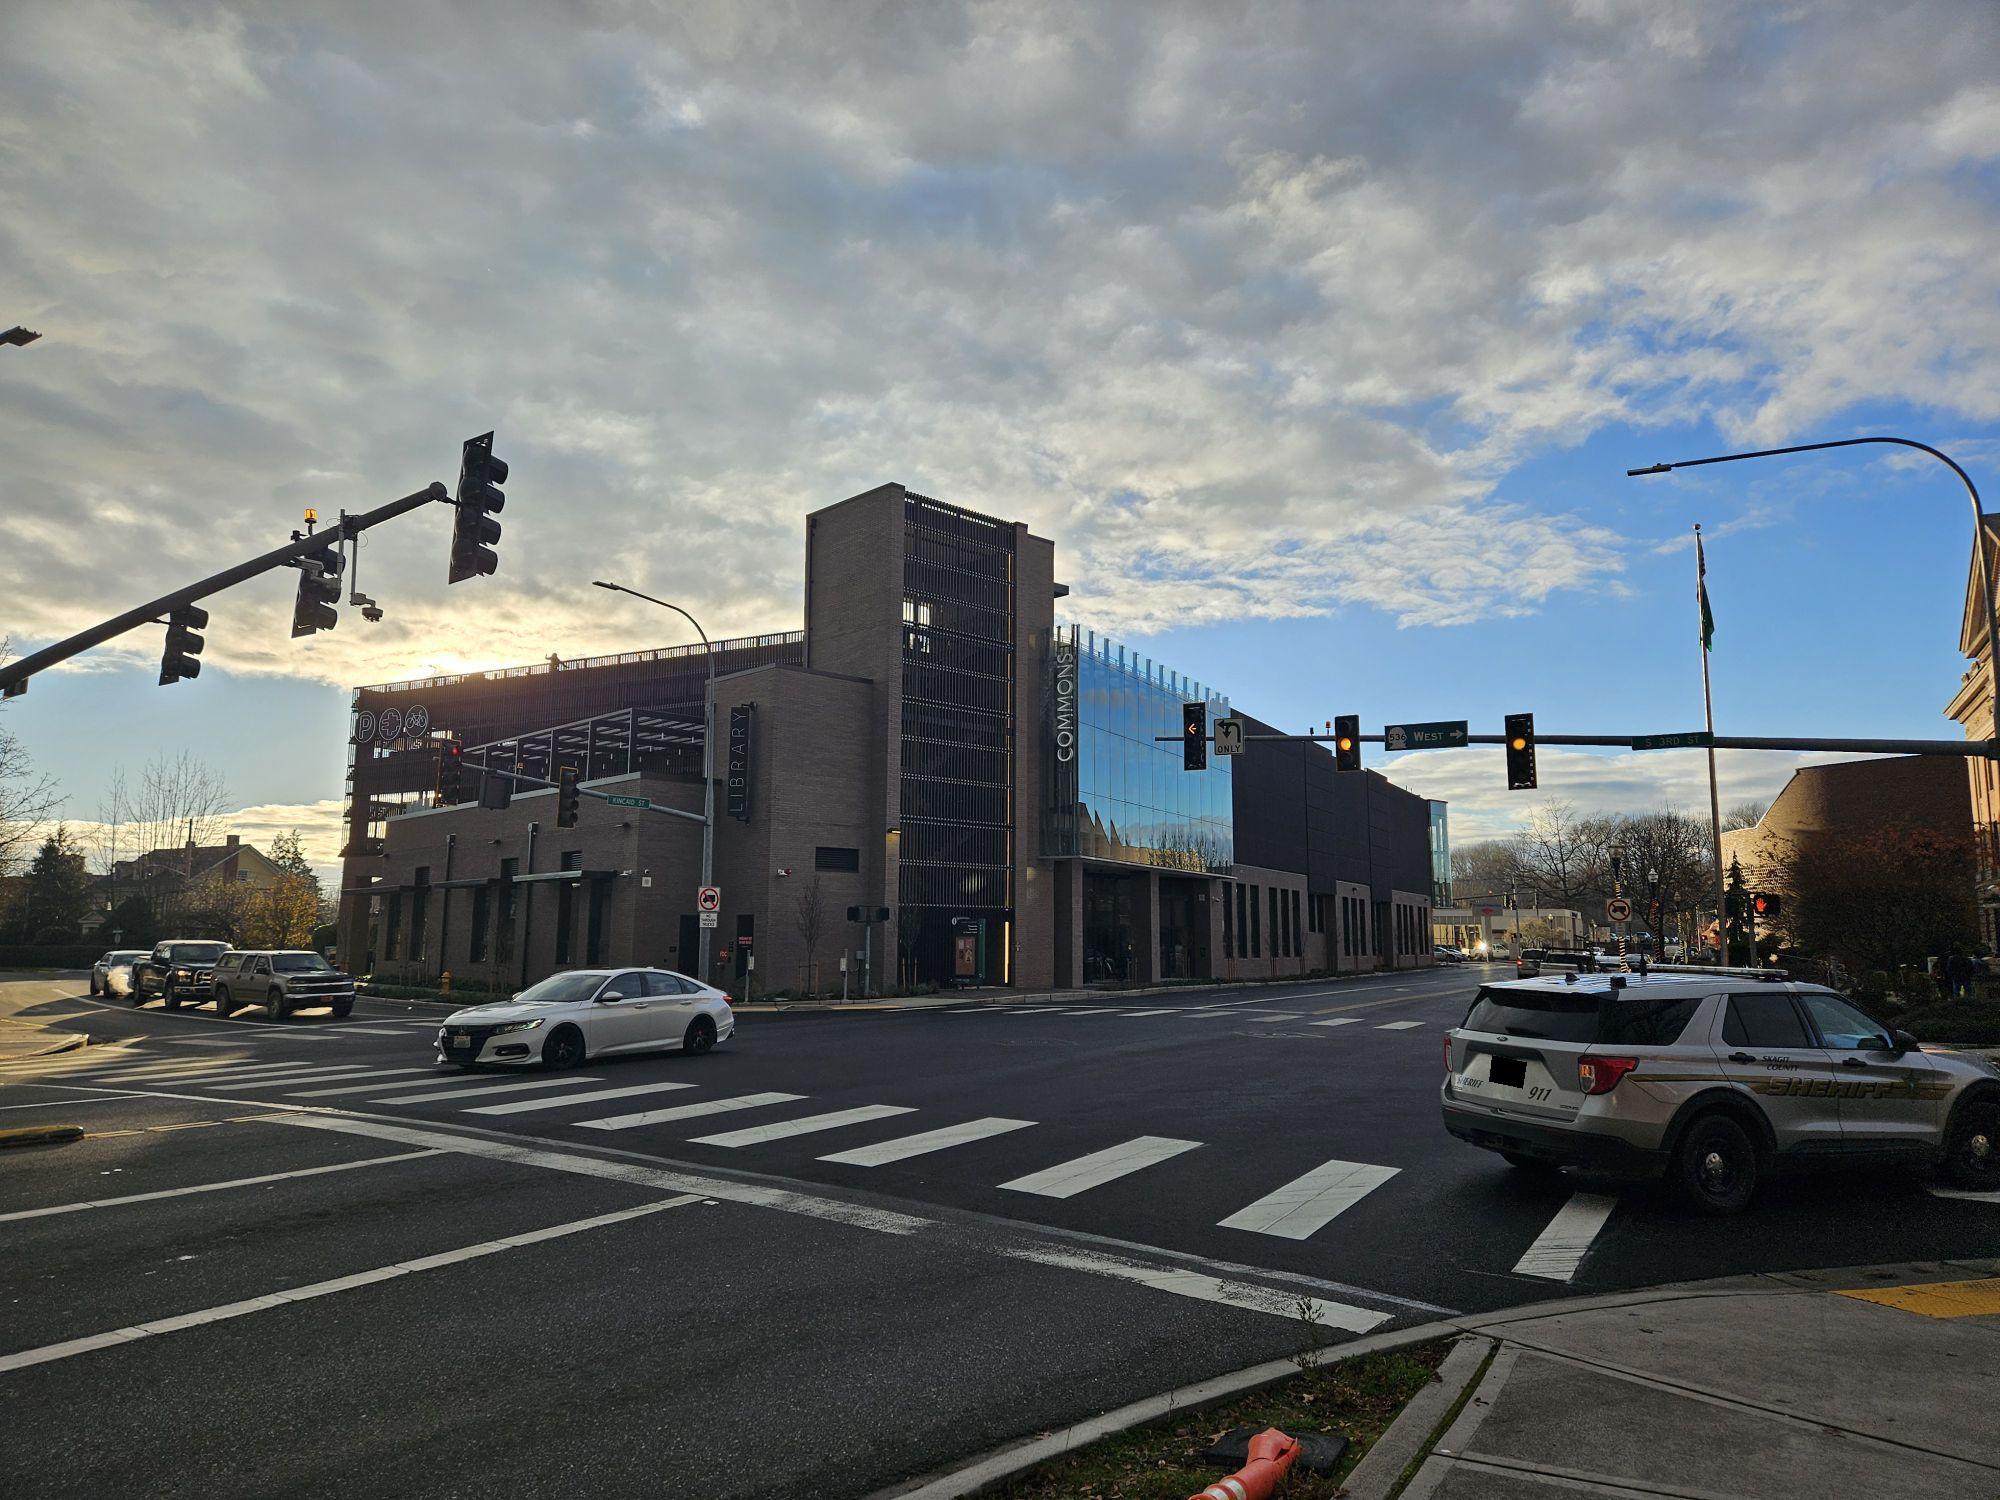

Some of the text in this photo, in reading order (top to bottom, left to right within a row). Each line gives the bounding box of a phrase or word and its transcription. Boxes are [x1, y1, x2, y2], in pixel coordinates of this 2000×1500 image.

[1057, 653, 1073, 762] COMMONS
[359, 715, 373, 739] P
[1389, 731, 1444, 742] 536 WEST
[1646, 735, 1699, 747] S 3RD ST
[1217, 744, 1241, 753] ONLY
[729, 712, 747, 812] LIBRARY
[1762, 1055, 1790, 1063] SKAGIT
[1767, 1063, 1799, 1071] COUNTY
[1457, 1074, 1484, 1089] SHERIFF
[1767, 1076, 1892, 1099] SHERIFF
[1527, 1086, 1552, 1101] 911
